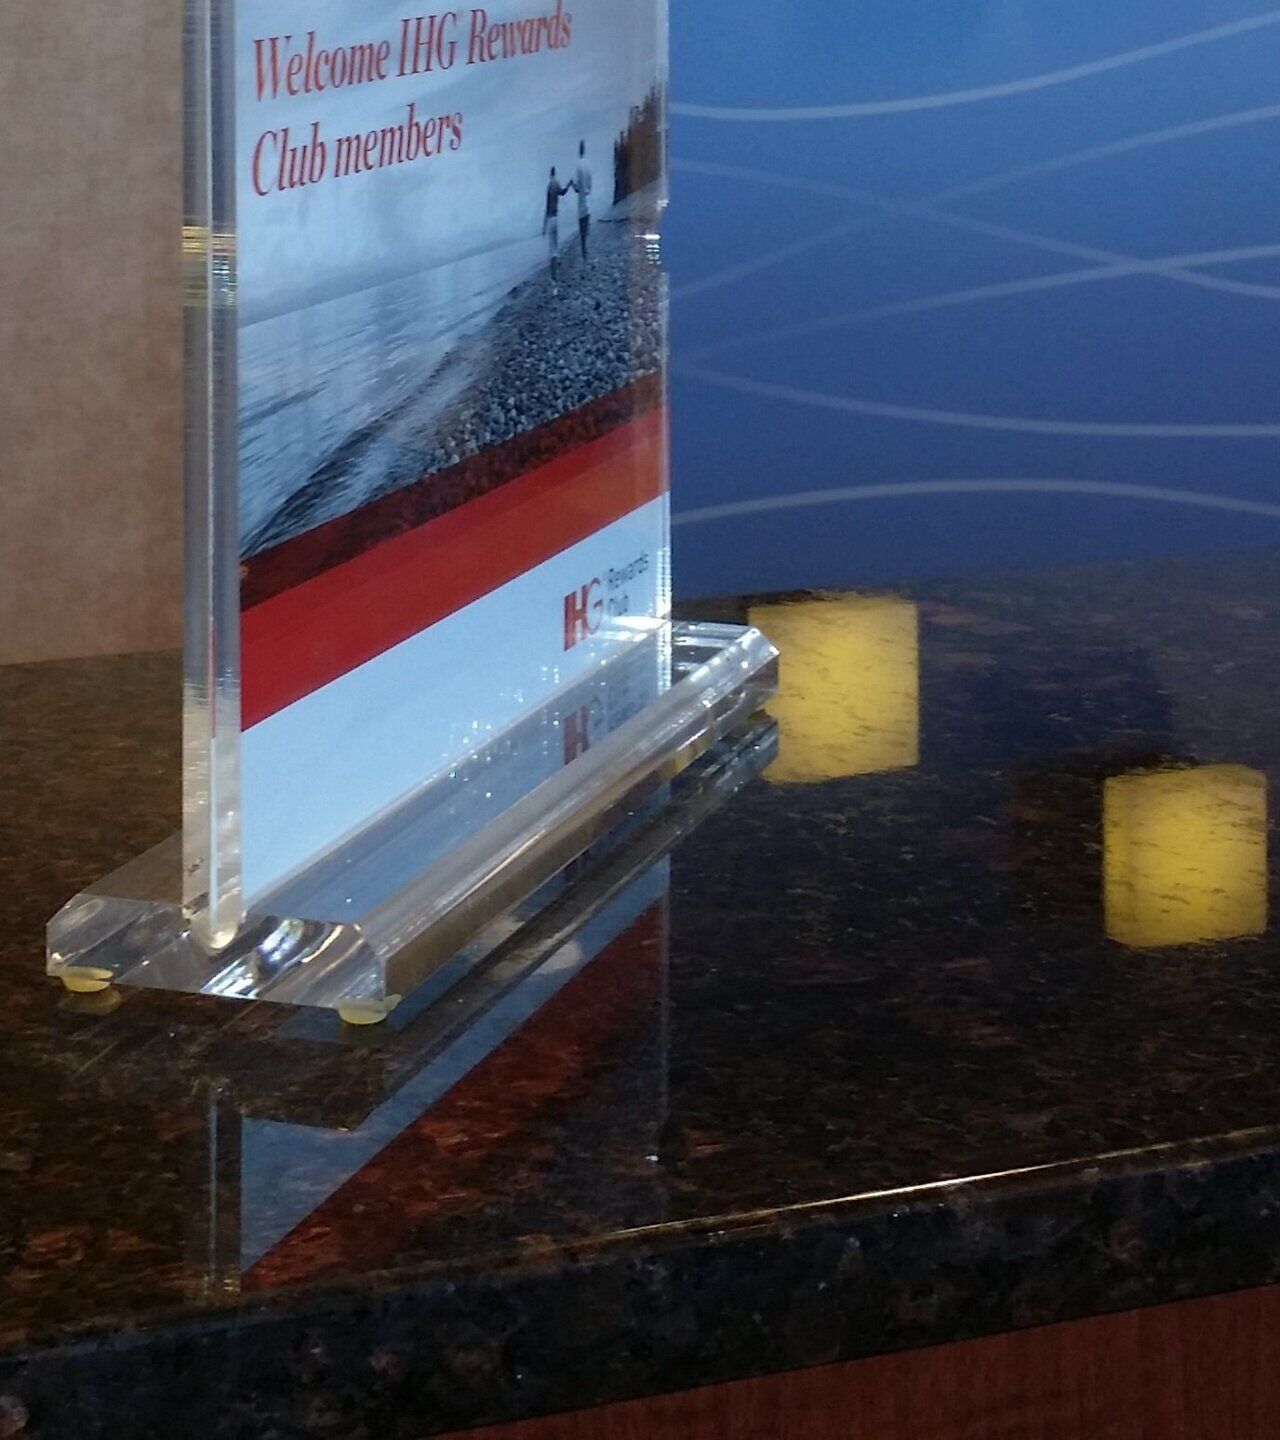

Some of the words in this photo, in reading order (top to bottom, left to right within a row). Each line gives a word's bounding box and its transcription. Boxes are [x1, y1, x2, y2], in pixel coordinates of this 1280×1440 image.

[252, 30, 391, 102] Welcome
[395, 10, 459, 77] IHG
[252, 122, 325, 197] Club
[334, 102, 464, 177] members
